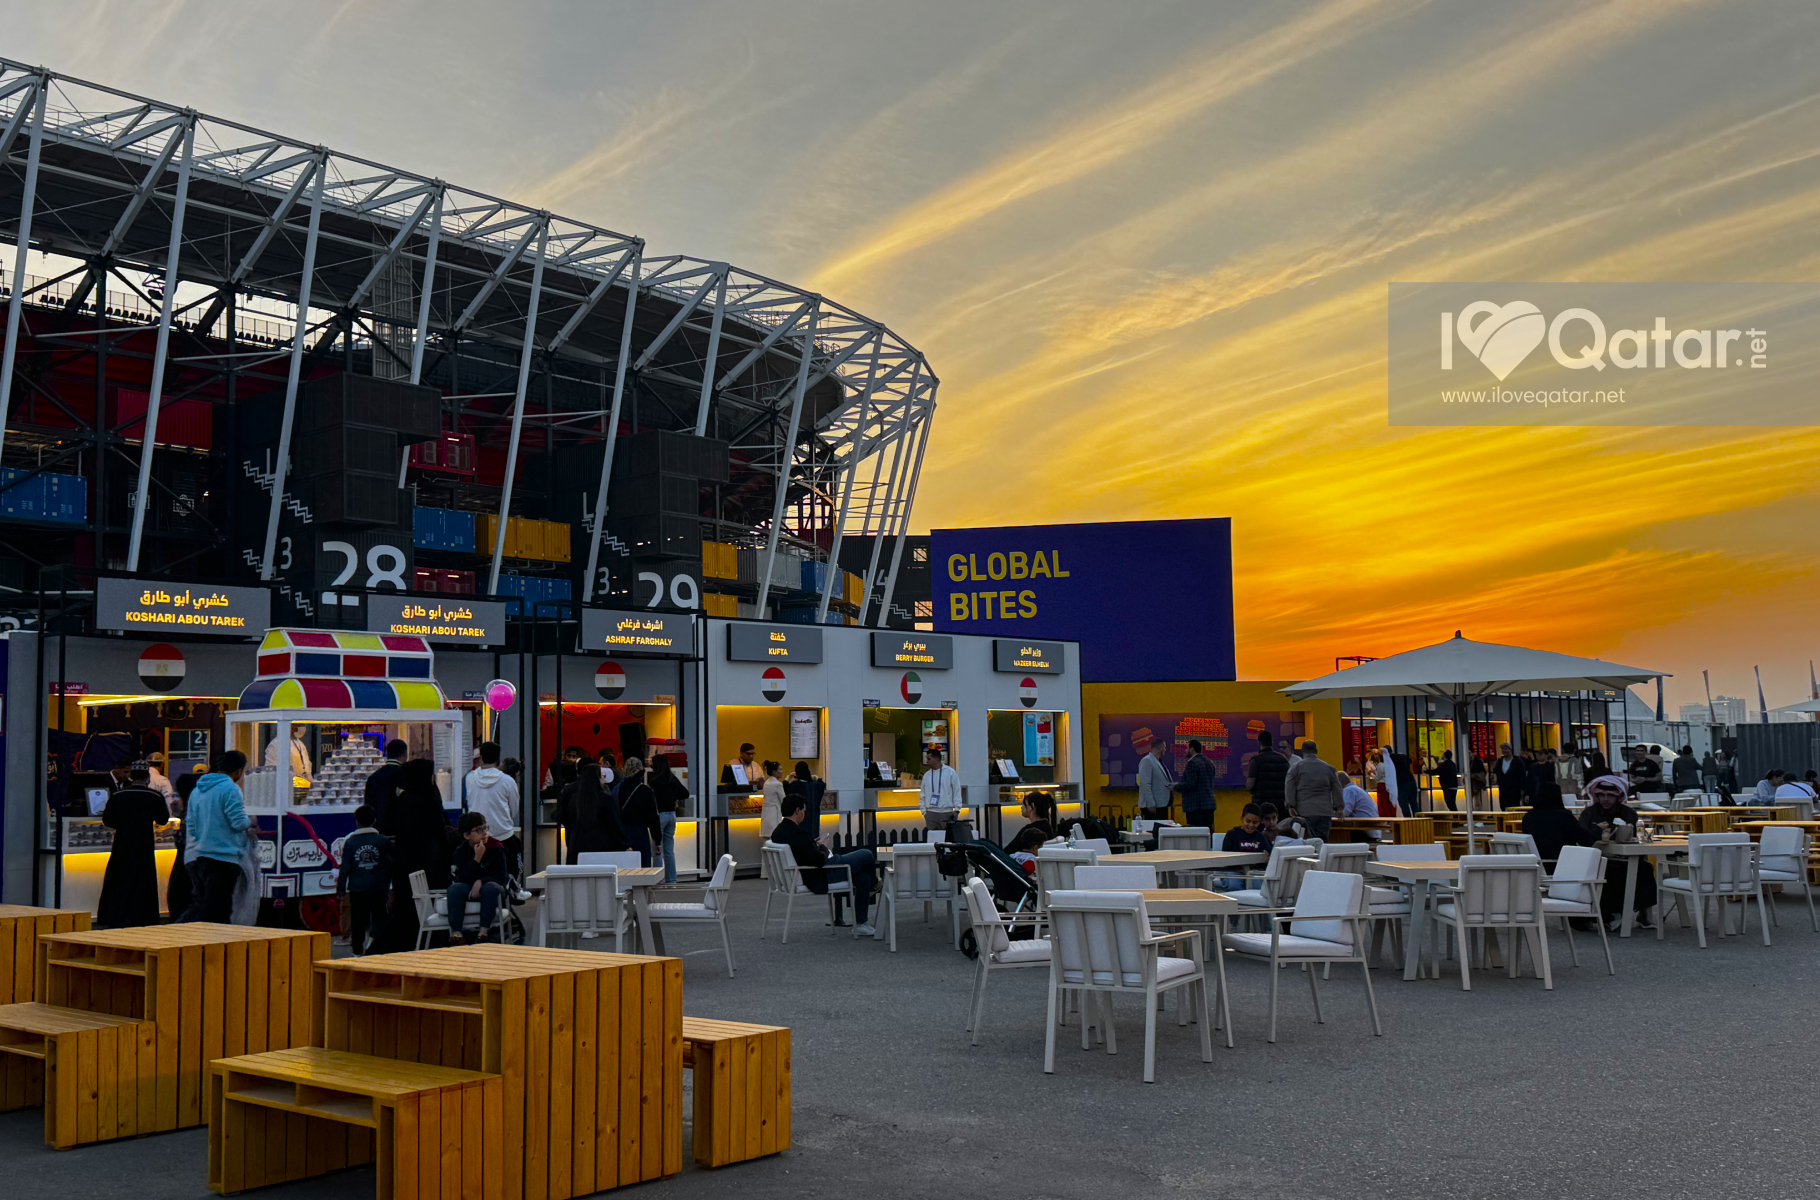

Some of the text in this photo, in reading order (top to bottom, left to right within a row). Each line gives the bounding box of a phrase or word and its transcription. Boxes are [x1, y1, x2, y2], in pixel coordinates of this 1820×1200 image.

[322, 540, 407, 606] 28
[947, 550, 1070, 582] GLOBAL
[638, 571, 699, 610] 29
[140, 589, 229, 610] كشري أبو طارق
[950, 589, 1038, 621] BITES
[126, 611, 245, 627] KOSHARI ABOU TAREK
[401, 604, 473, 622] كشري أبو طارق
[390, 624, 486, 637] KOSHARI ABOU TAREK
[617, 618, 641, 632] فرغلي
[605, 635, 673, 646] ASHRAF FARGHALY
[768, 647, 789, 656] KUFTA
[895, 653, 935, 663] BERRY BURGER
